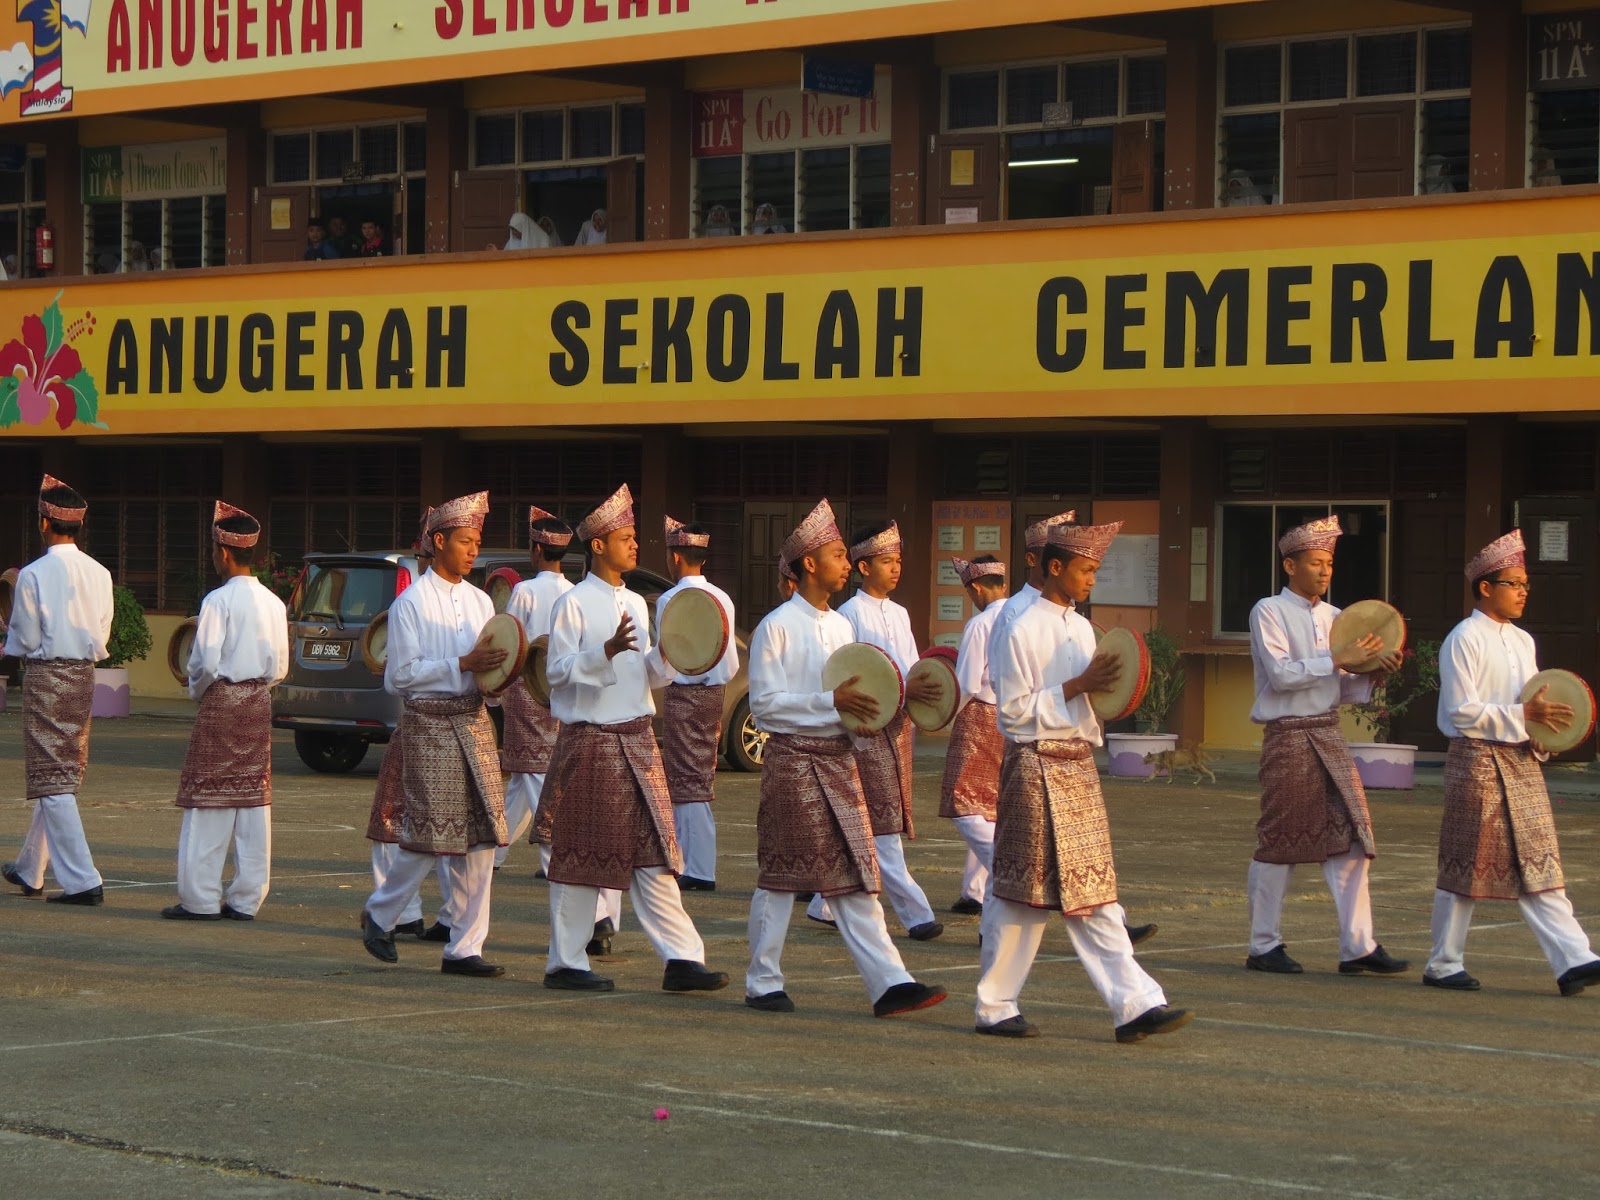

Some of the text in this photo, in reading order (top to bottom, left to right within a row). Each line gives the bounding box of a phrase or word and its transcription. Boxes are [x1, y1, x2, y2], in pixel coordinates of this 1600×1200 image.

[106, 0, 363, 73] ANUGERAH
[1543, 20, 1583, 42] SPM
[28, 92, 66, 109] Malaysia
[701, 97, 730, 116] SPM
[755, 90, 881, 142] Go For It
[105, 251, 1600, 395] ANUGERAH SEKOLAH CEMERLAN
[324, 645, 341, 656] 5962
